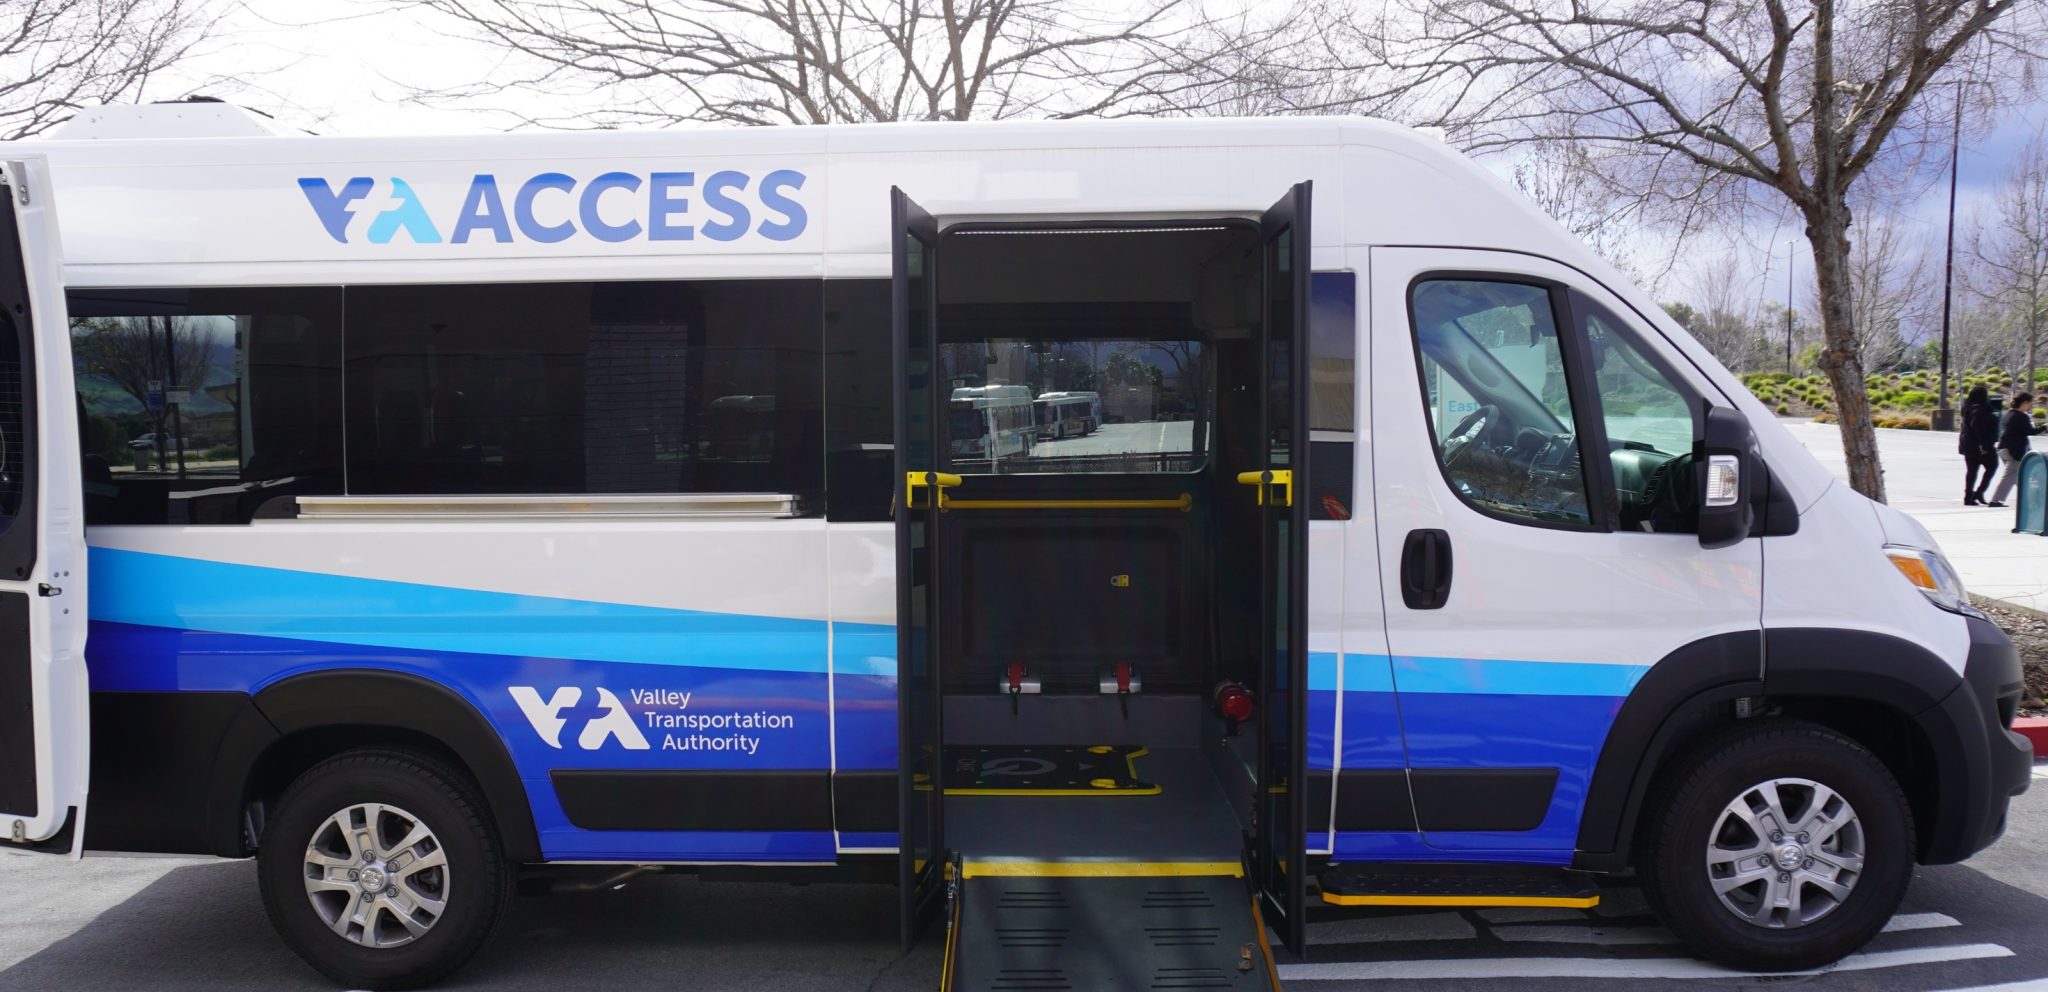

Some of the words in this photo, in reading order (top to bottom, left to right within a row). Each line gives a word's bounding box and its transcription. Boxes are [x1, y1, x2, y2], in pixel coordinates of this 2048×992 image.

[450, 168, 808, 244] ACCESS
[630, 687, 692, 710] Valley
[645, 710, 794, 731] Transportation
[662, 733, 760, 755] Authority
